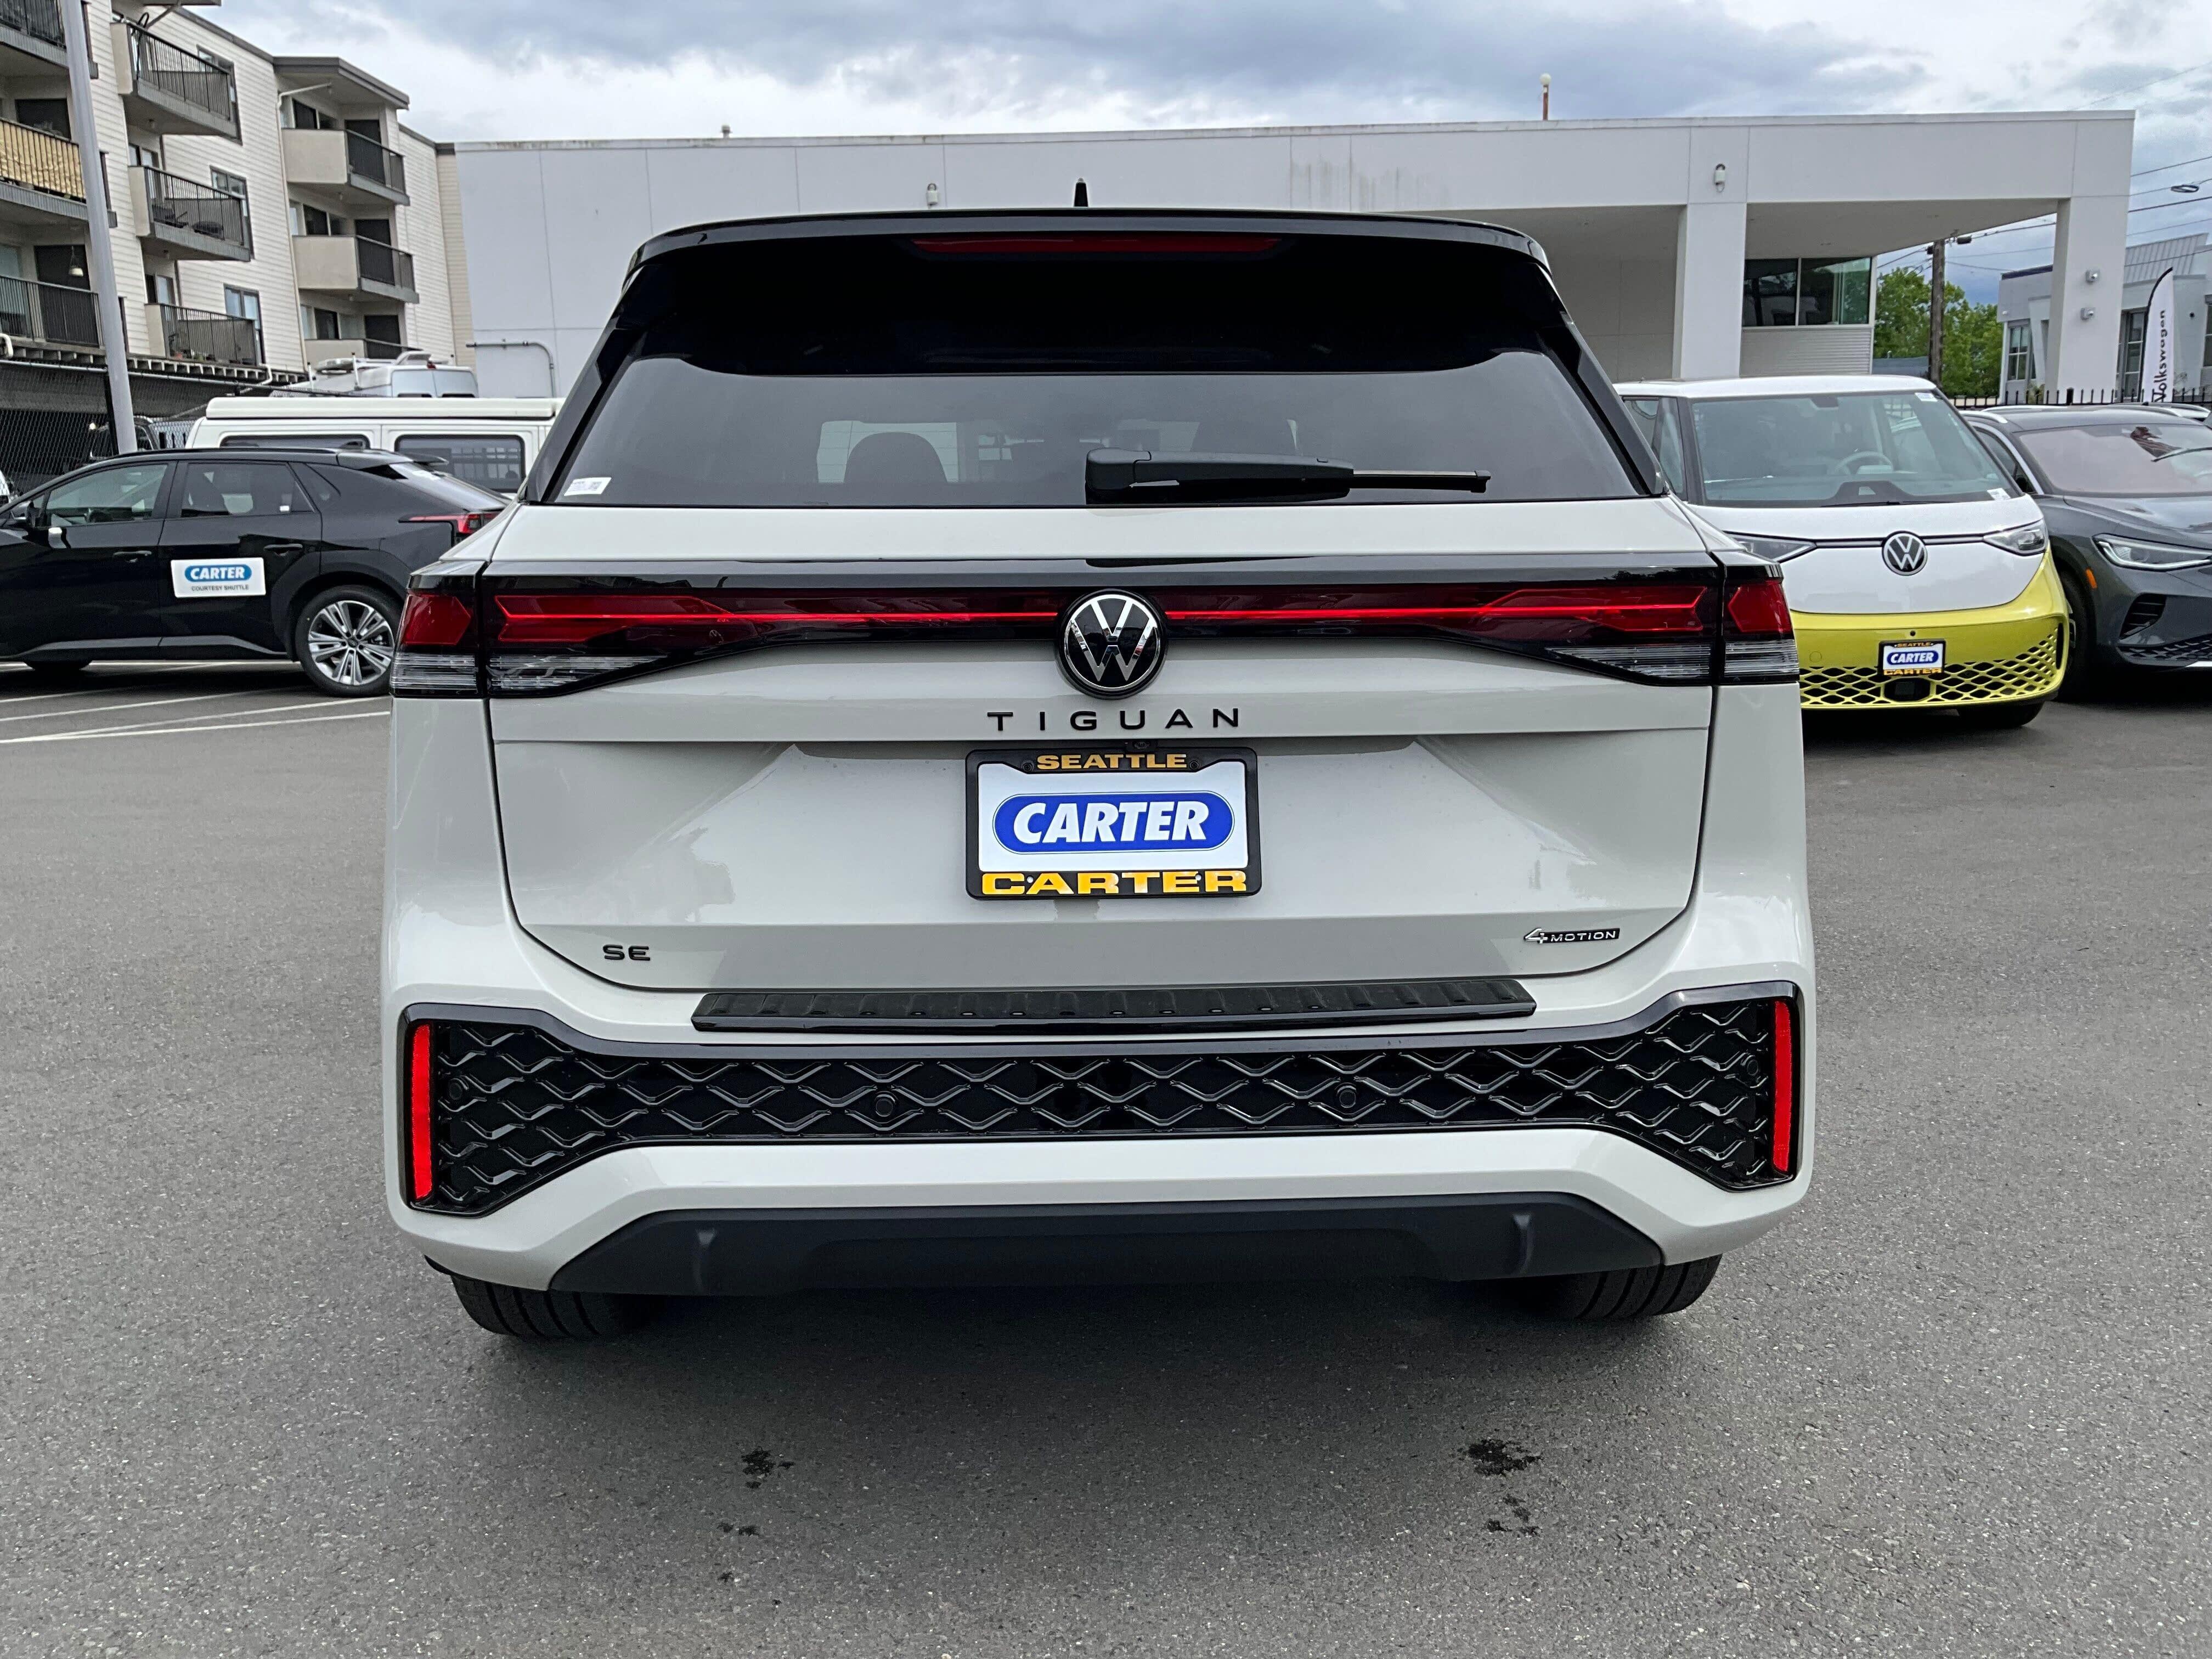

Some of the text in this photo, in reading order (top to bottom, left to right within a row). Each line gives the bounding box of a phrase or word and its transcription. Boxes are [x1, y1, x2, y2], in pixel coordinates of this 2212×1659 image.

[2153, 310, 2168, 402] Volkswagen
[1883, 533, 1927, 575] VW
[190, 566, 245, 580] CARTER
[1064, 594, 1158, 689] VW
[1891, 652, 1934, 663] CARTER
[987, 708, 1239, 731] TIGUAN
[1036, 753, 1188, 769] SEATTLE
[1013, 800, 1209, 844] CARTER
[981, 870, 1247, 895] CARTER
[1525, 928, 1617, 944] 4MOTION
[602, 944, 651, 961] SE
